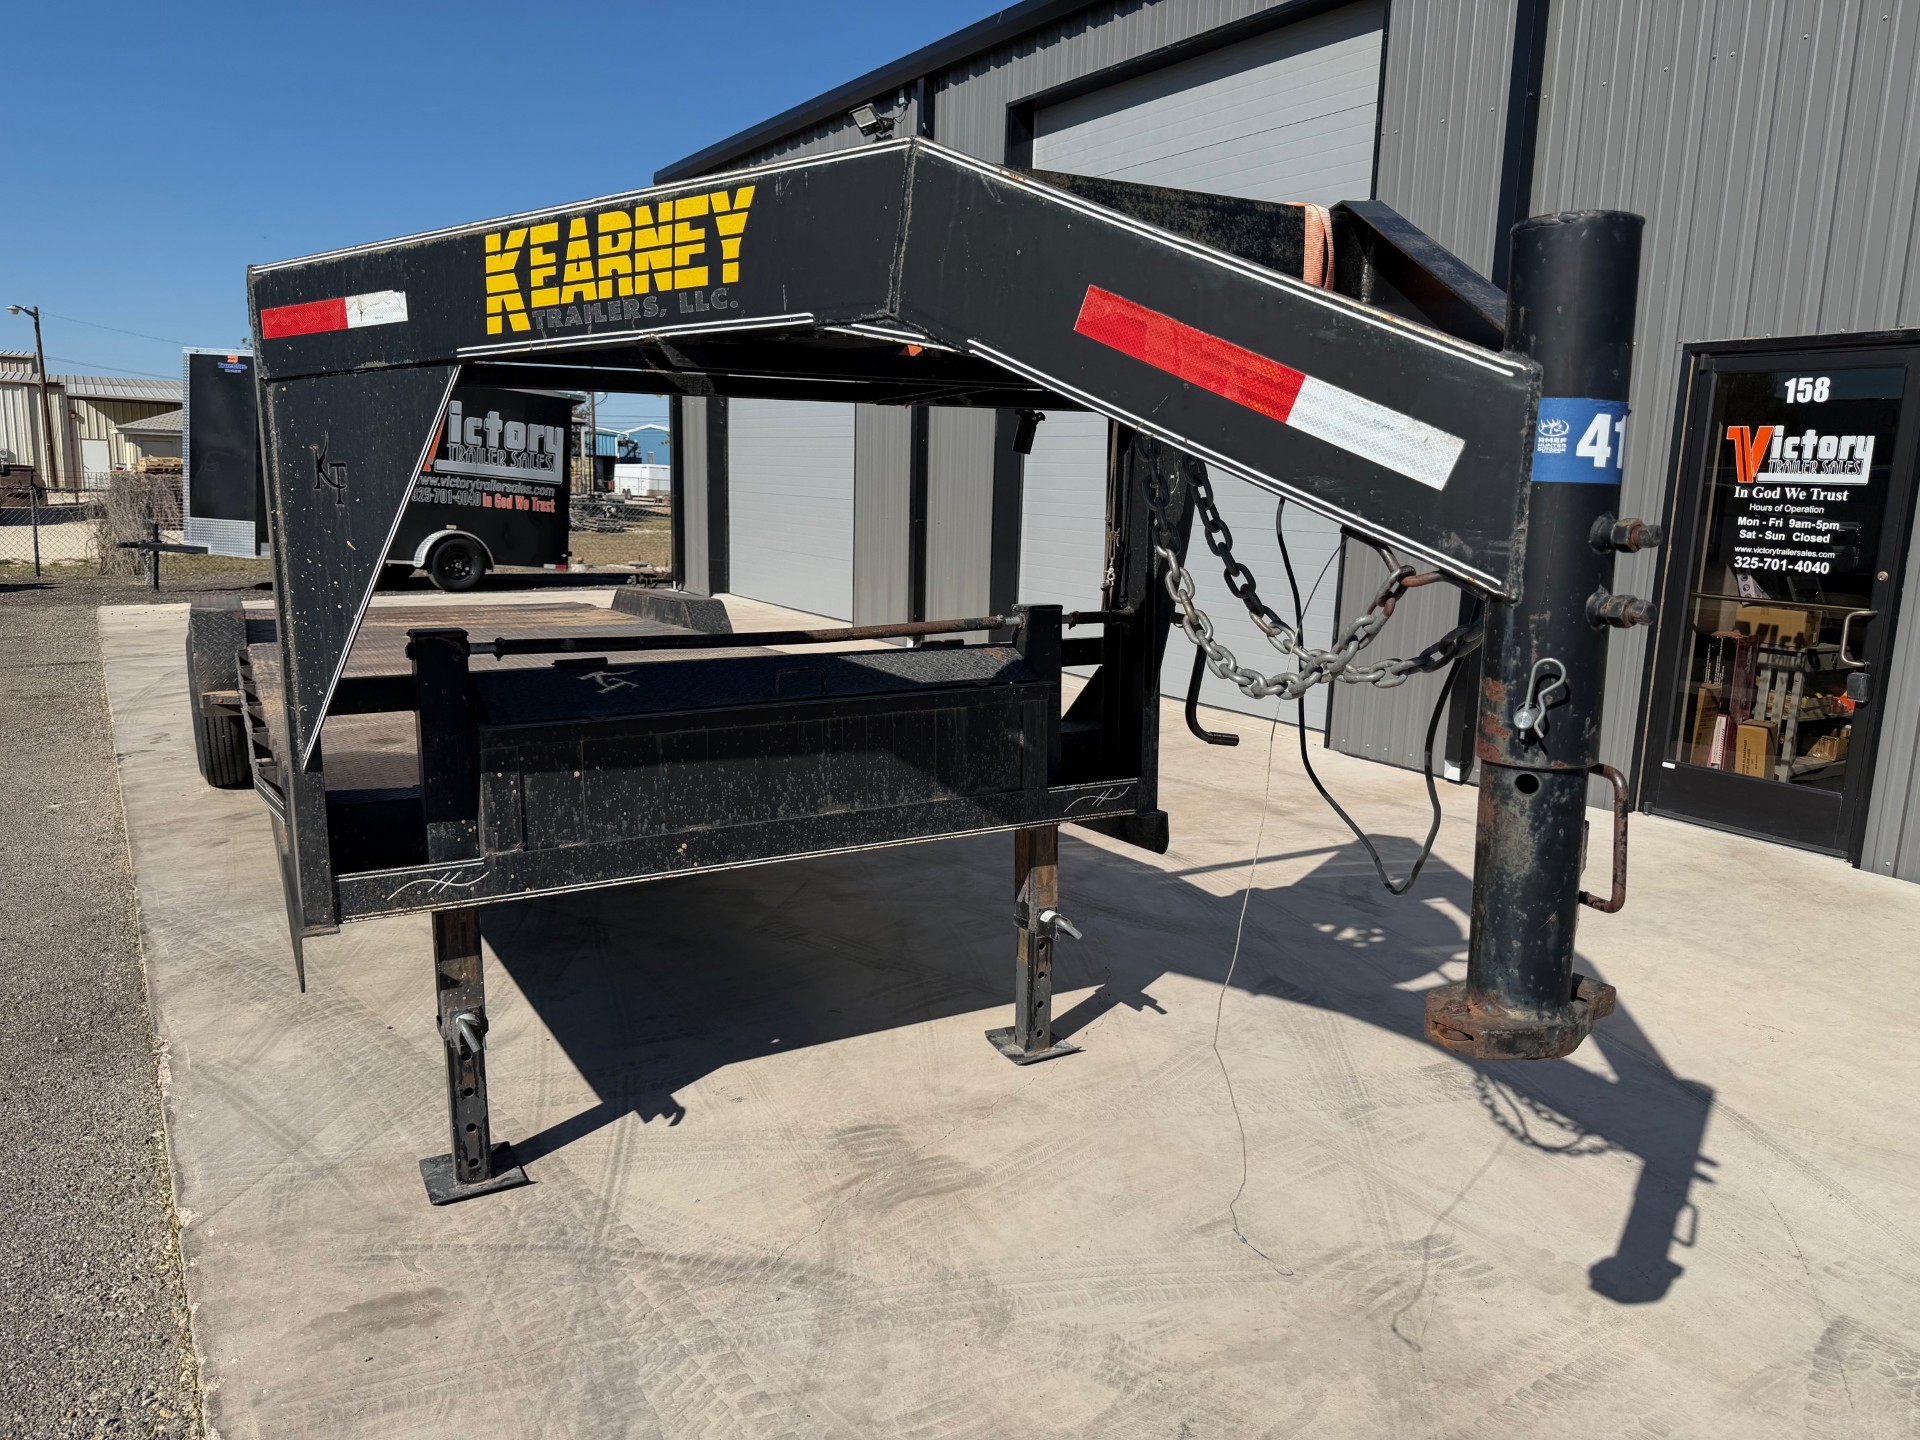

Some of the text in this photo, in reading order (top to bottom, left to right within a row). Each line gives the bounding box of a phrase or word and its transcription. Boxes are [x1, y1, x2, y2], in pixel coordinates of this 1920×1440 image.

[485, 185, 756, 335] KEARNEY
[531, 287, 739, 330] TRAILERS, LLC.
[1784, 376, 1831, 404] 158
[423, 400, 564, 484] ictory
[447, 444, 553, 472] TRAILER SALES
[1726, 425, 1875, 485] Victory
[1768, 459, 1862, 475] TRAILER SALES
[482, 492, 492, 508] In
[494, 493, 513, 510] God
[515, 495, 529, 511] We
[531, 497, 555, 513] Trust
[1733, 486, 1849, 501] In God We Trust
[1749, 503, 1825, 514] Hours of Operation
[1737, 516, 1760, 526] Mon
[1768, 517, 1783, 527] Fri
[1788, 519, 1840, 531] 9am-5pm
[1739, 529, 1756, 539] Sat
[1764, 530, 1785, 541] Sun
[1792, 532, 1831, 543] Closed
[1734, 546, 1835, 559] www.victorytrailersales.com
[1734, 556, 1830, 575] 325-701-4040
